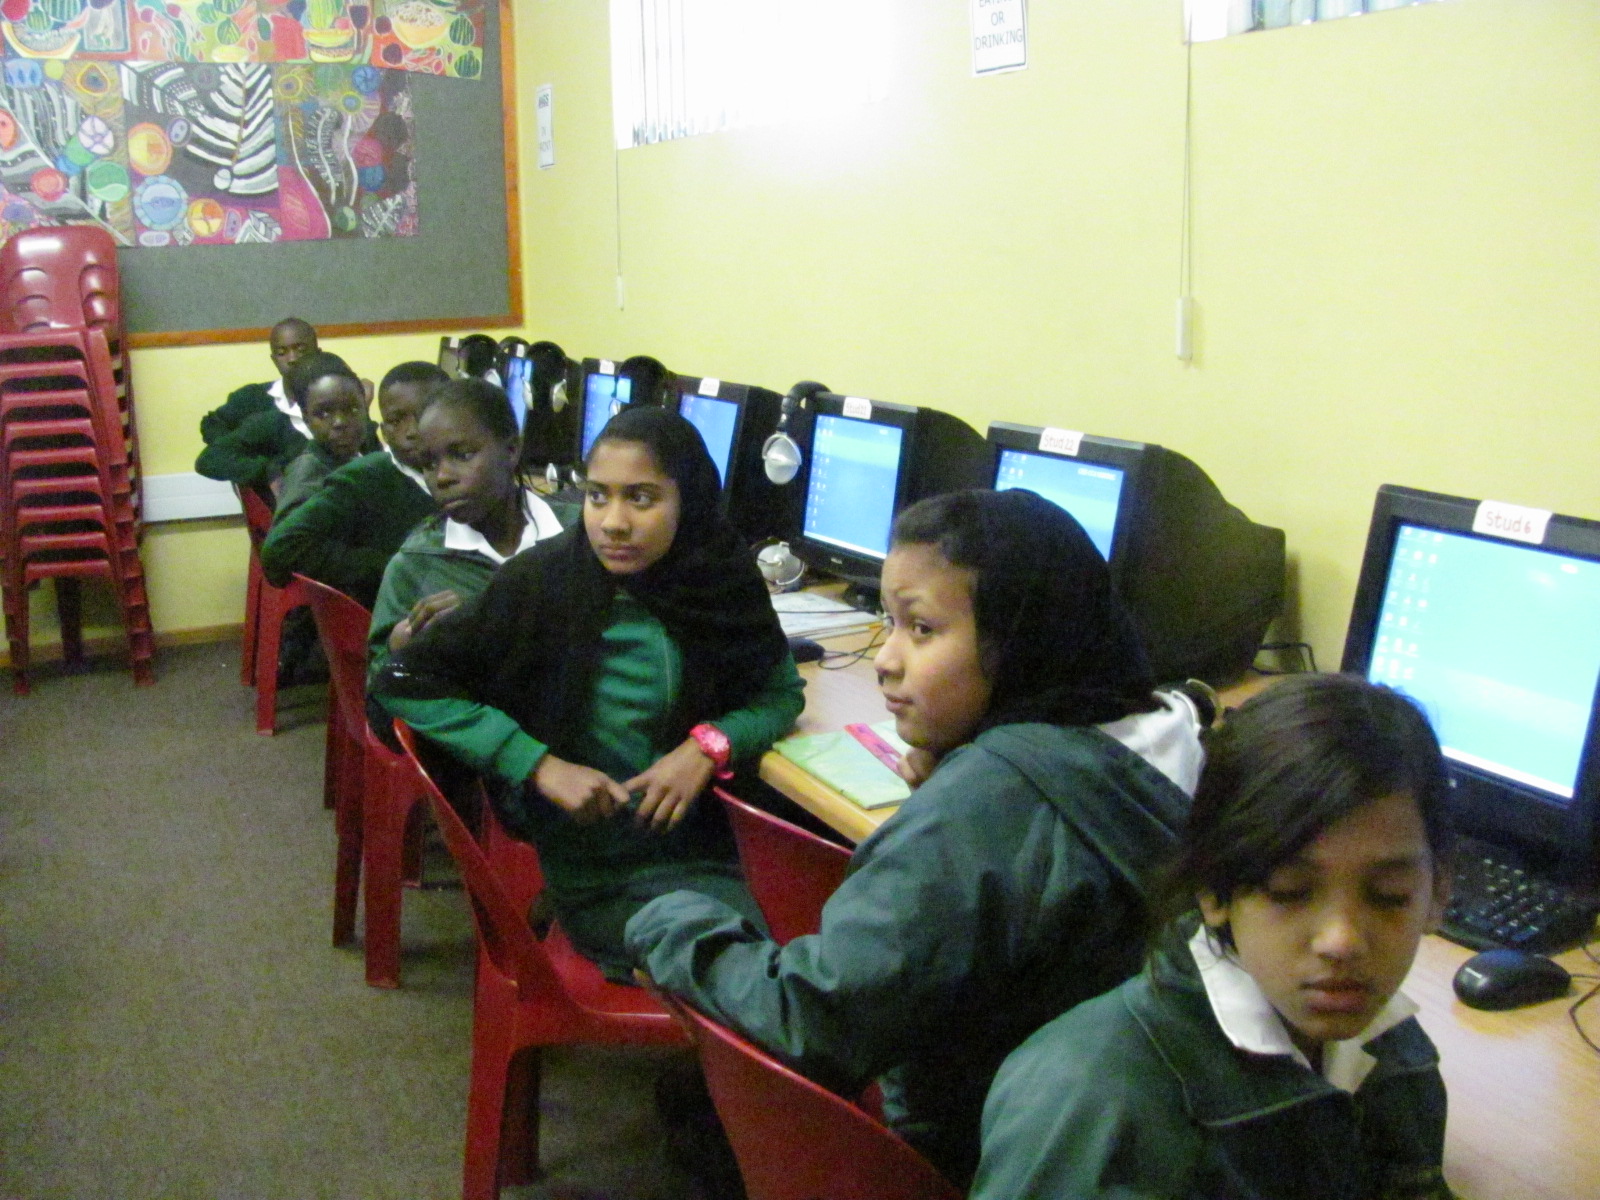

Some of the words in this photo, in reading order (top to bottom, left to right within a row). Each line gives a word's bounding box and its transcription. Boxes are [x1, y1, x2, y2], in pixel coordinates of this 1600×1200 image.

[991, 11, 1005, 26] OR
[975, 28, 1023, 50] DRINKING
[1486, 511, 1522, 532] Stud
[1524, 520, 1531, 534] 6
